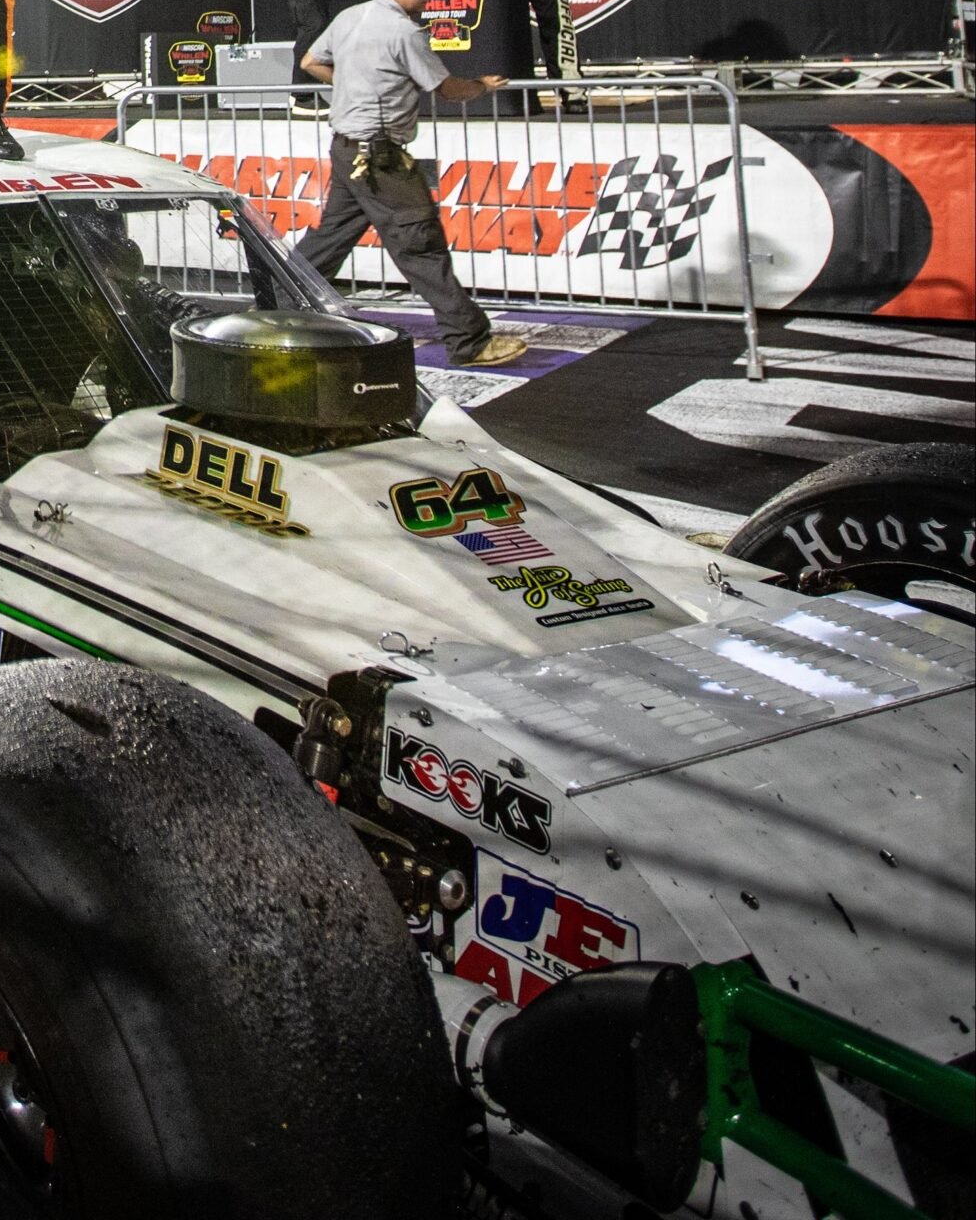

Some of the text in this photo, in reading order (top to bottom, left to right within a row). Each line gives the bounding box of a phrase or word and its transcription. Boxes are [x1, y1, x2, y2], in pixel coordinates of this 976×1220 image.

[161, 427, 286, 514] DELL
[394, 468, 518, 535] 64
[489, 565, 572, 609] The Joie
[552, 578, 633, 608] of Seating
[542, 613, 573, 625] Custom
[385, 727, 551, 855] KOOKS
